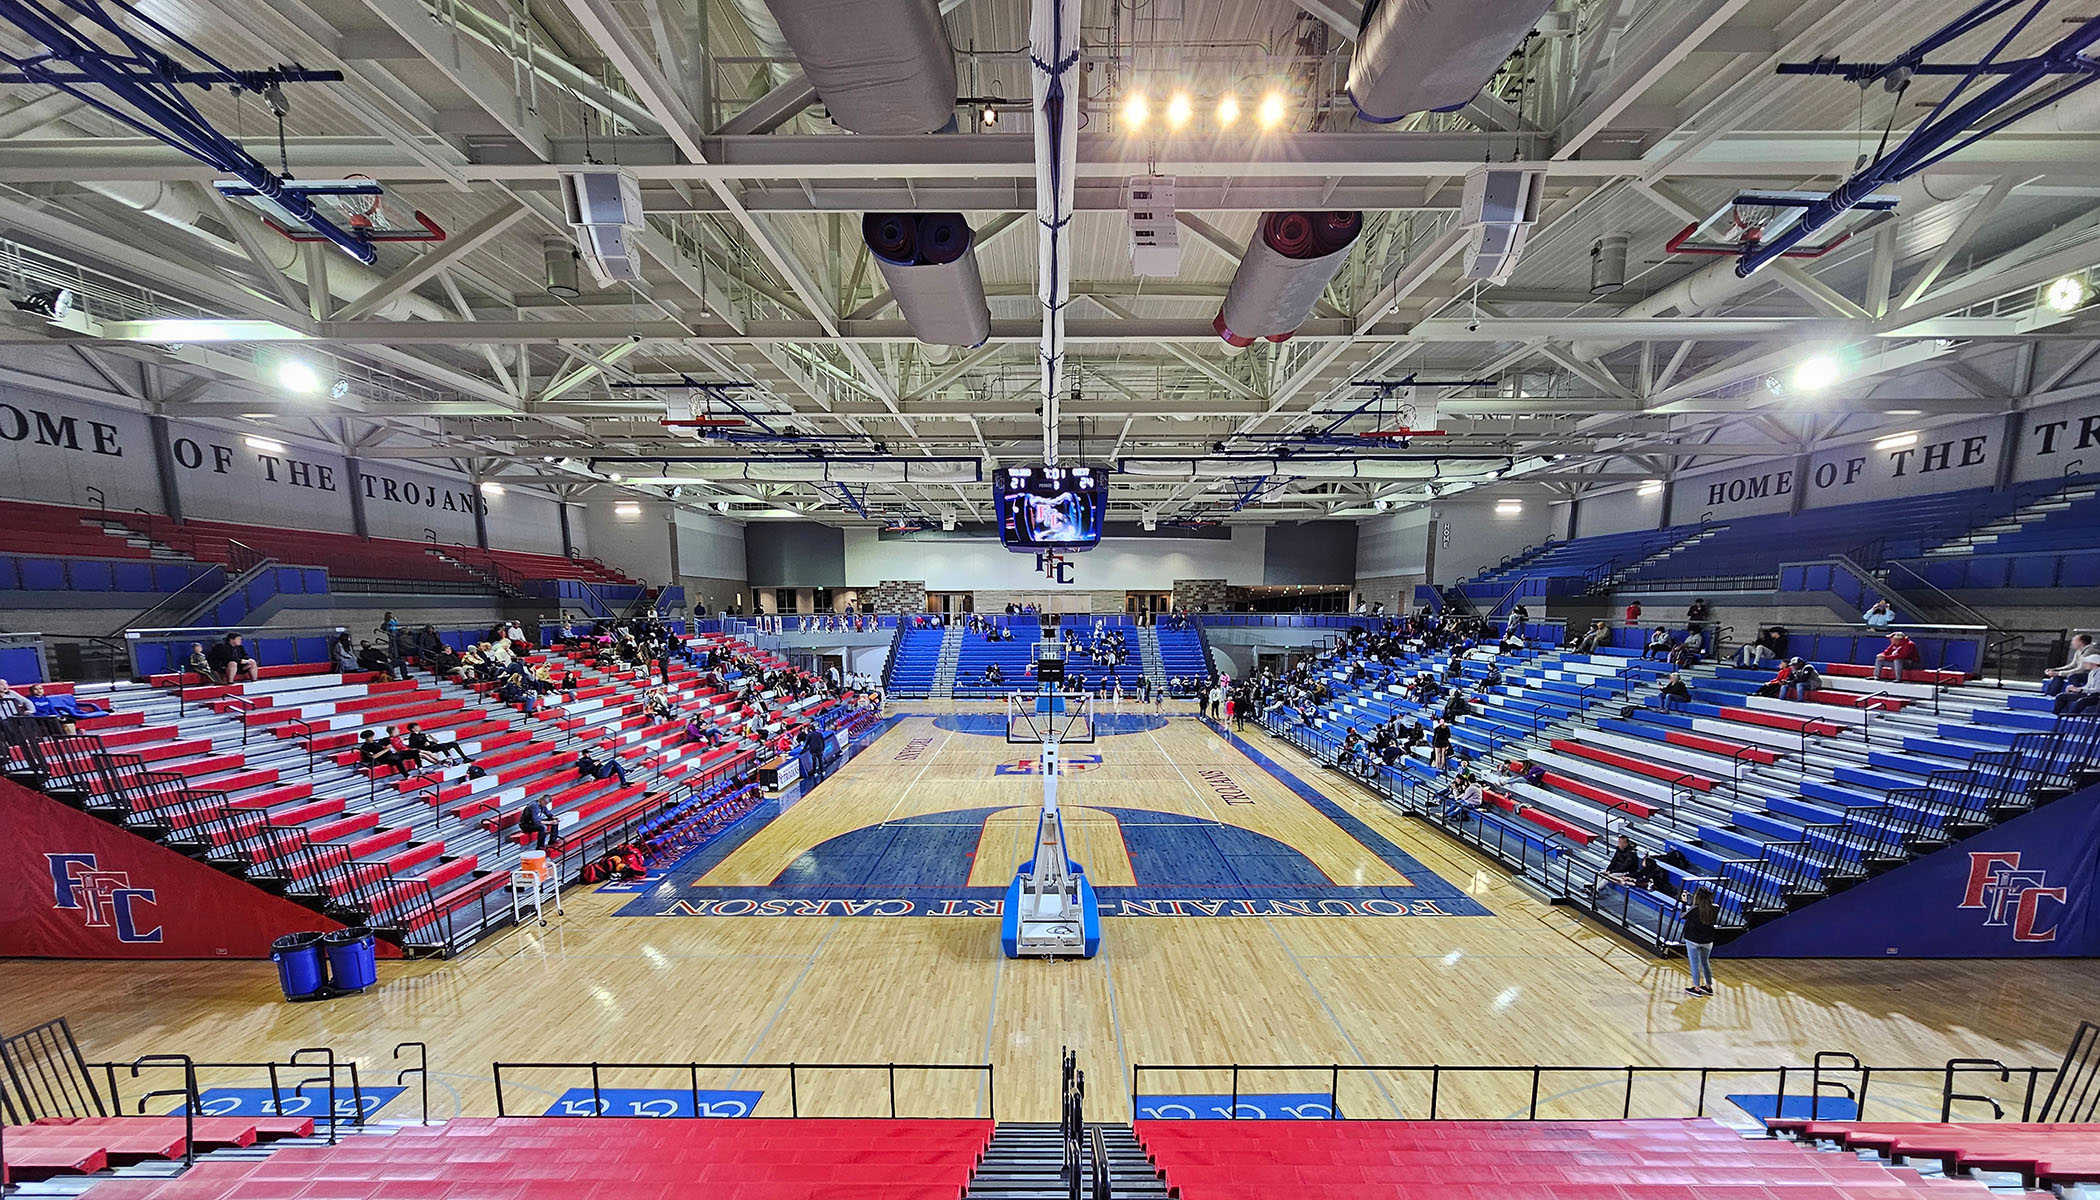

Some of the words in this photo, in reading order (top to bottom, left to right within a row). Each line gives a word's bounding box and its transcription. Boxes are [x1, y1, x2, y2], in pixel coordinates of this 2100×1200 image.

[173, 438, 233, 474] OF
[258, 454, 336, 491] THE
[1079, 476, 1094, 489] 24
[1707, 471, 1793, 506] HOME
[1815, 457, 1866, 488] OF
[1890, 435, 1987, 477] THE
[1010, 477, 1025, 489] 21
[1442, 523, 1450, 549] HOME
[1198, 770, 1256, 806] TROJANS
[43, 853, 163, 943] FFC
[655, 899, 915, 916] CARSON
[1957, 851, 2067, 942] FFC
